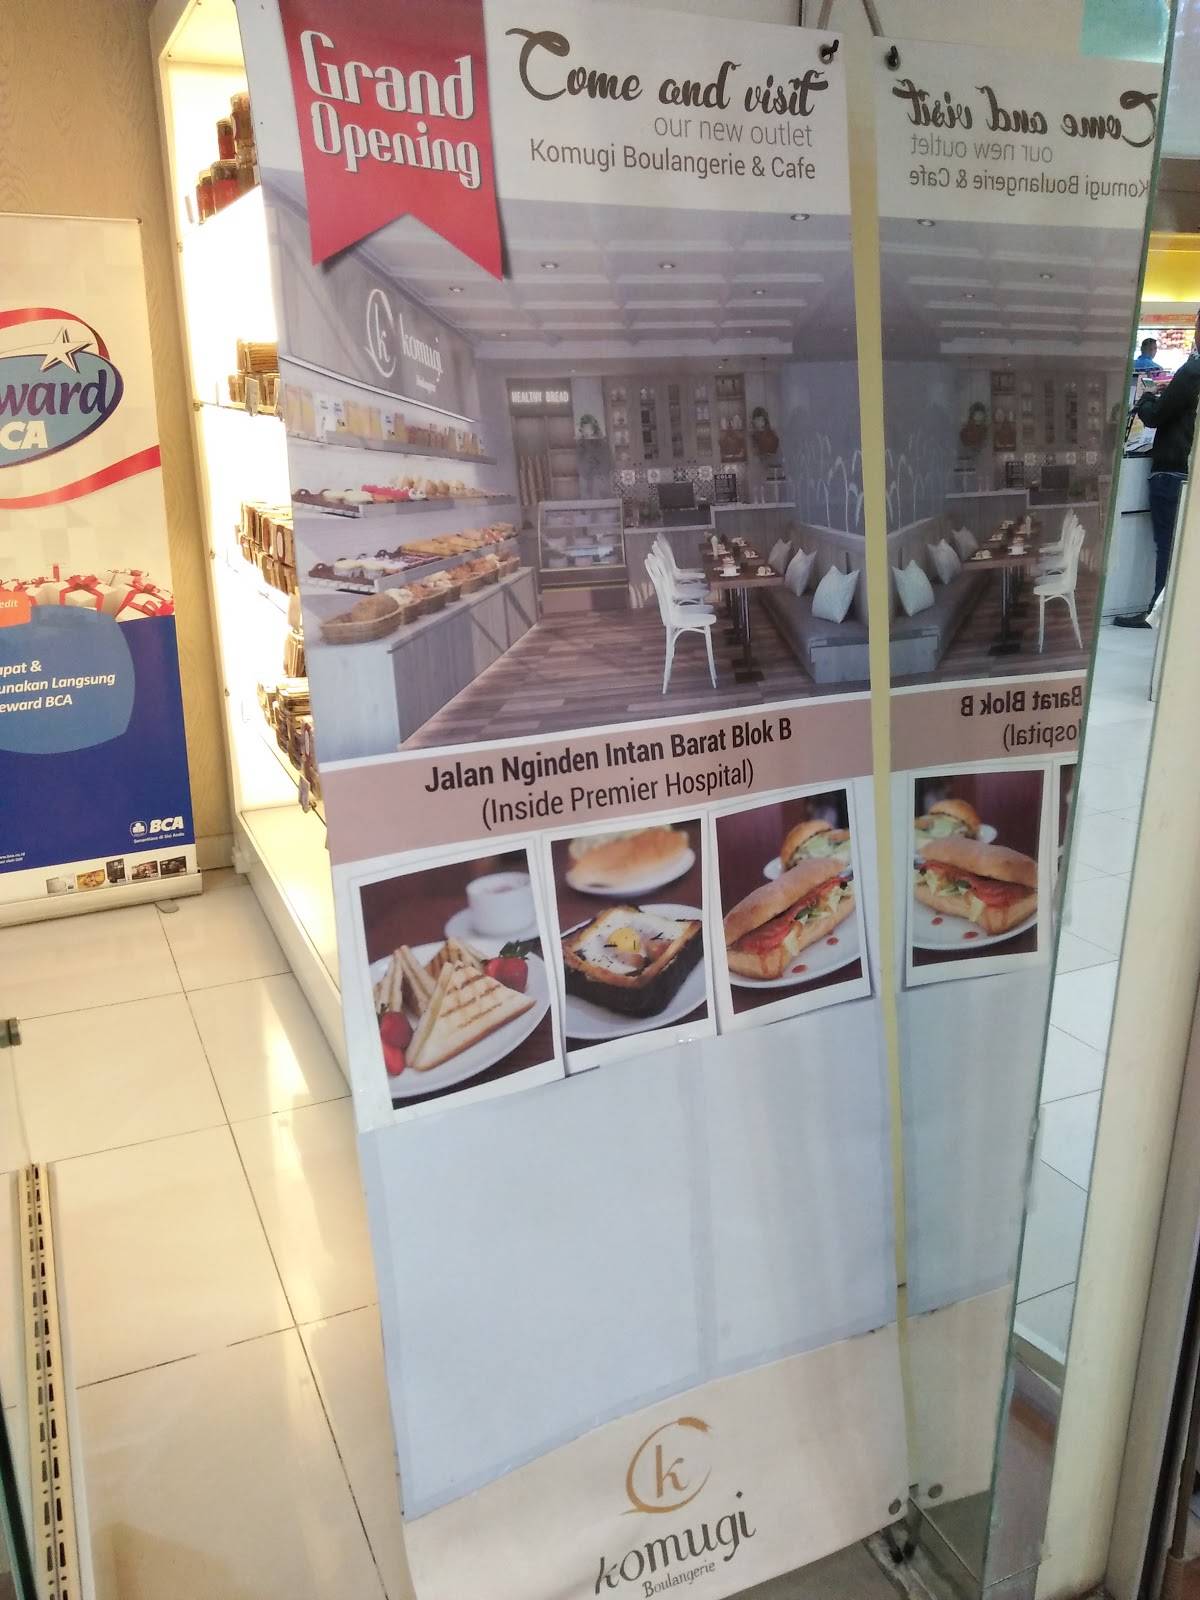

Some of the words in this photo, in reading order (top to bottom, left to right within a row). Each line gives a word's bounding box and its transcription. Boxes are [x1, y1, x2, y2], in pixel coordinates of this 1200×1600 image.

[301, 29, 475, 121] Grand
[505, 28, 642, 101] Come
[659, 61, 740, 111] and
[745, 69, 829, 118] visit
[311, 101, 481, 190] Opening
[530, 138, 616, 170] Komugi
[624, 143, 746, 179] Boulangerie
[752, 157, 766, 178] &
[771, 157, 817, 180] Cafe
[654, 117, 695, 140] our
[700, 121, 743, 144] new
[751, 123, 813, 148] outlet
[400, 313, 443, 382] komugi
[30, 660, 42, 673] &
[52, 673, 116, 689] Langsung
[45, 694, 73, 709] BCA
[425, 763, 494, 793] Jalan
[502, 746, 599, 786] Nginden
[605, 738, 665, 768] Intan
[671, 728, 726, 758] Barat
[732, 718, 774, 749] Blok
[779, 717, 793, 741] B
[482, 790, 563, 831] (Inside
[571, 776, 658, 813] Premier
[666, 758, 754, 798] Hospital)
[149, 816, 184, 834] BCA
[594, 1490, 757, 1595] komugi
[641, 1559, 717, 1599] Boulangerie
